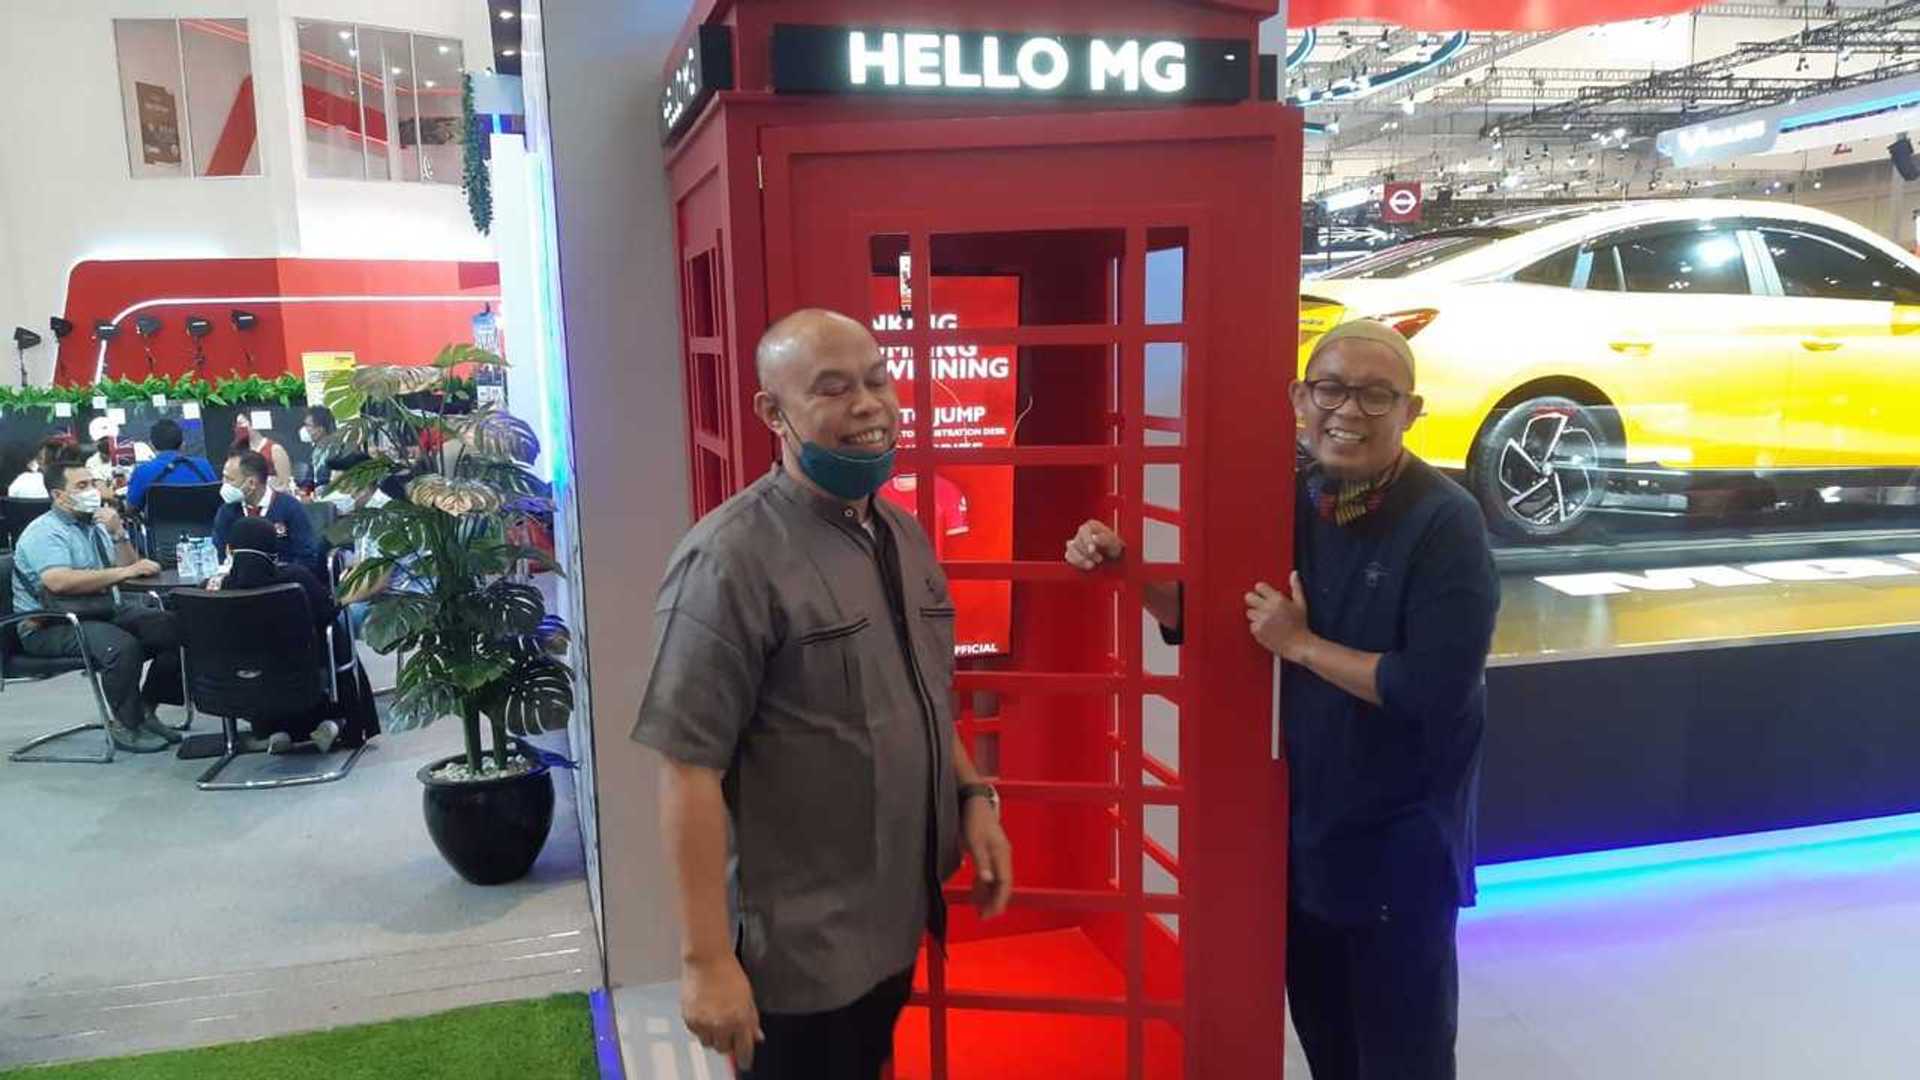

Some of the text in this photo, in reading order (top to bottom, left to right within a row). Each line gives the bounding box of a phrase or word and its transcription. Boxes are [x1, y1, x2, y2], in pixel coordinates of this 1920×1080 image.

[849, 31, 1187, 94] HELLO MG
[932, 405, 986, 427] JUMP
[954, 643, 998, 655] FFICIAL
